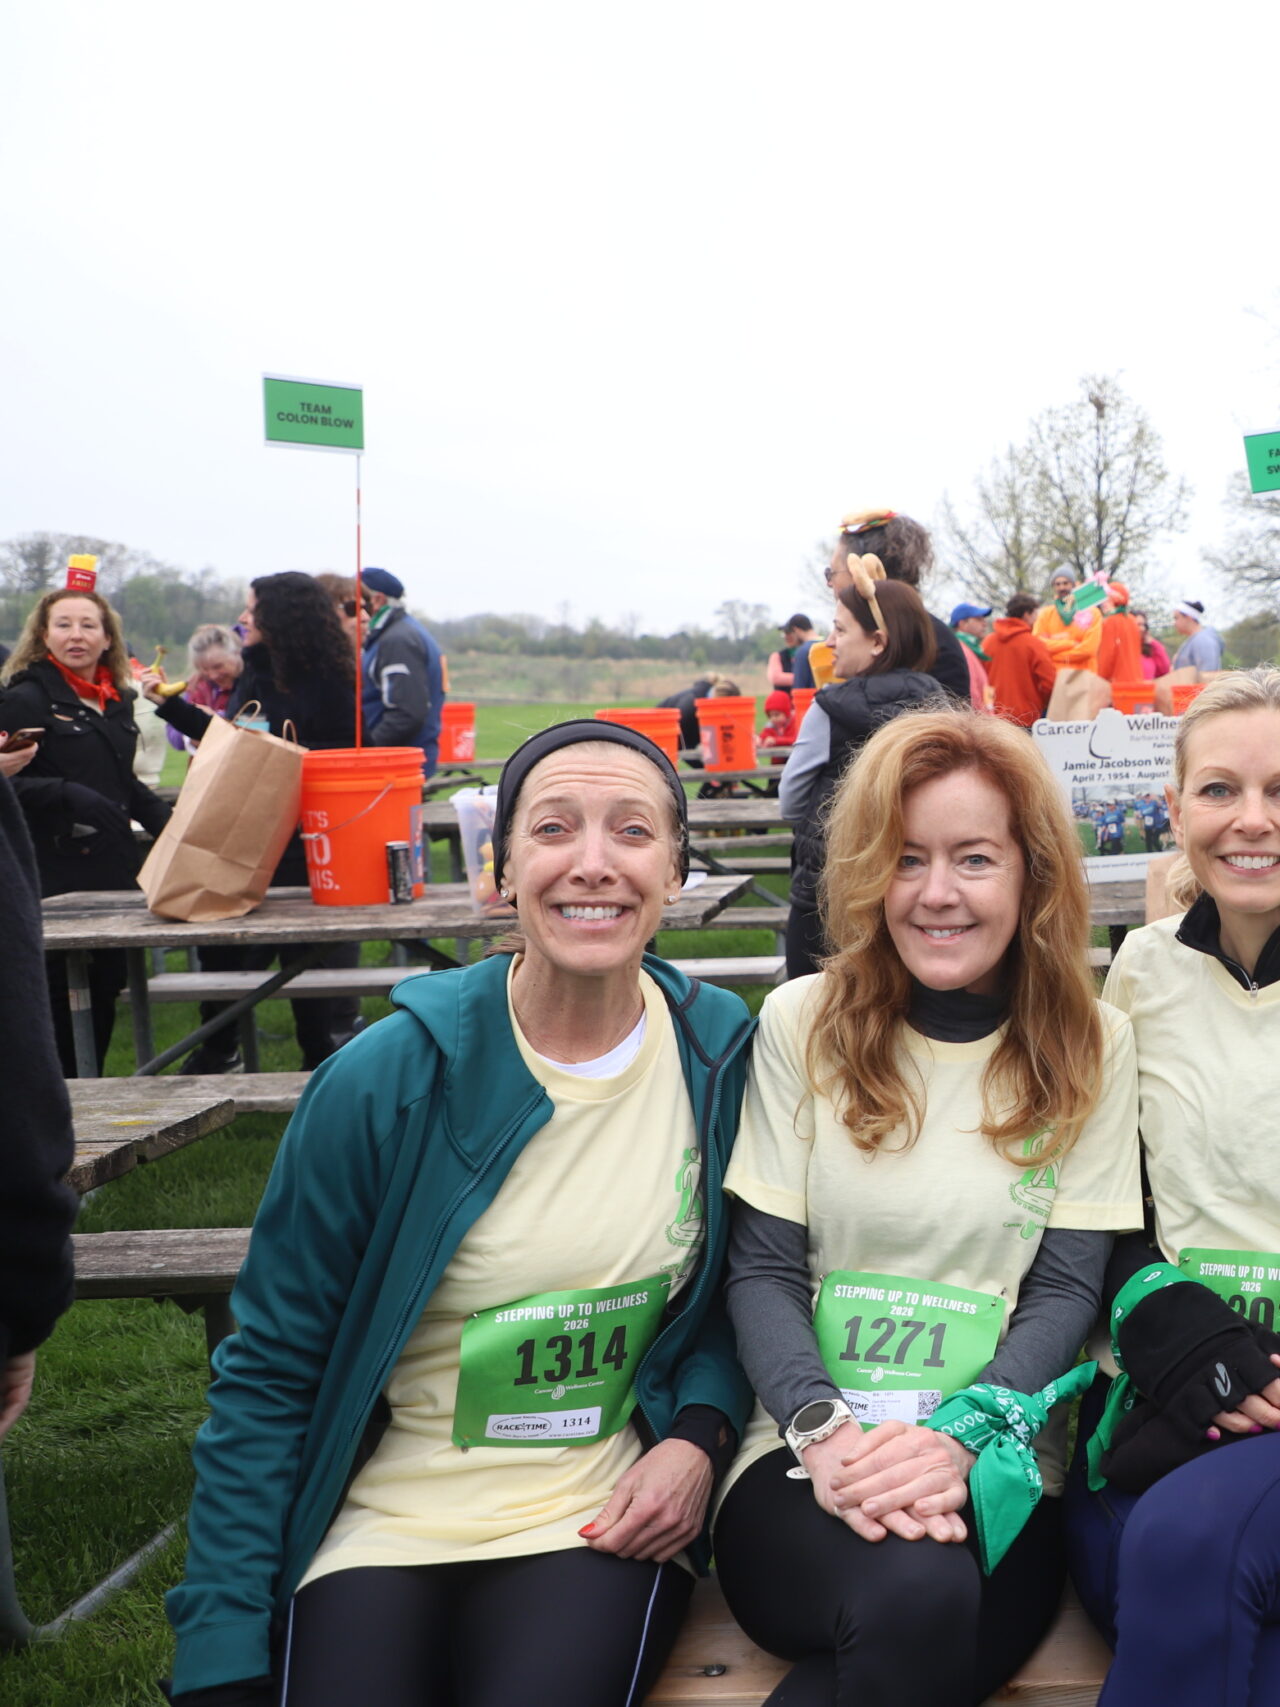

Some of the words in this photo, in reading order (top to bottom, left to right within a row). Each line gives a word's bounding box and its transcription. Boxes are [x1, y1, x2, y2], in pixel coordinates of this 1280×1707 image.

[299, 402, 332, 414] TEAM
[276, 411, 318, 425] COLON
[320, 416, 354, 429] BLOW
[1036, 722, 1089, 737] Cancer
[1062, 760, 1097, 771] Jamie
[1099, 757, 1151, 769] Jacobson
[1072, 774, 1095, 784] April
[1096, 773, 1106, 782] 7,
[1107, 772, 1130, 780] 1954
[1137, 770, 1170, 780] August
[1200, 1263, 1236, 1278] STEPPING
[1238, 1265, 1250, 1279] UP
[1252, 1266, 1265, 1280] TO
[1240, 1281, 1262, 1293] 2026
[834, 1284, 885, 1302] STEPPING
[888, 1291, 902, 1303] UP
[906, 1292, 920, 1305] TO
[922, 1293, 977, 1315] WELLNESS
[495, 1304, 554, 1324] STEPPING
[558, 1304, 575, 1319] UP
[578, 1302, 593, 1316] TO
[596, 1291, 648, 1314] WELLNESS
[890, 1305, 915, 1317] 2026
[563, 1318, 589, 1331] 2026
[839, 1315, 947, 1368] 1271
[513, 1325, 628, 1386] 1314
[562, 1416, 591, 1428] 1314
